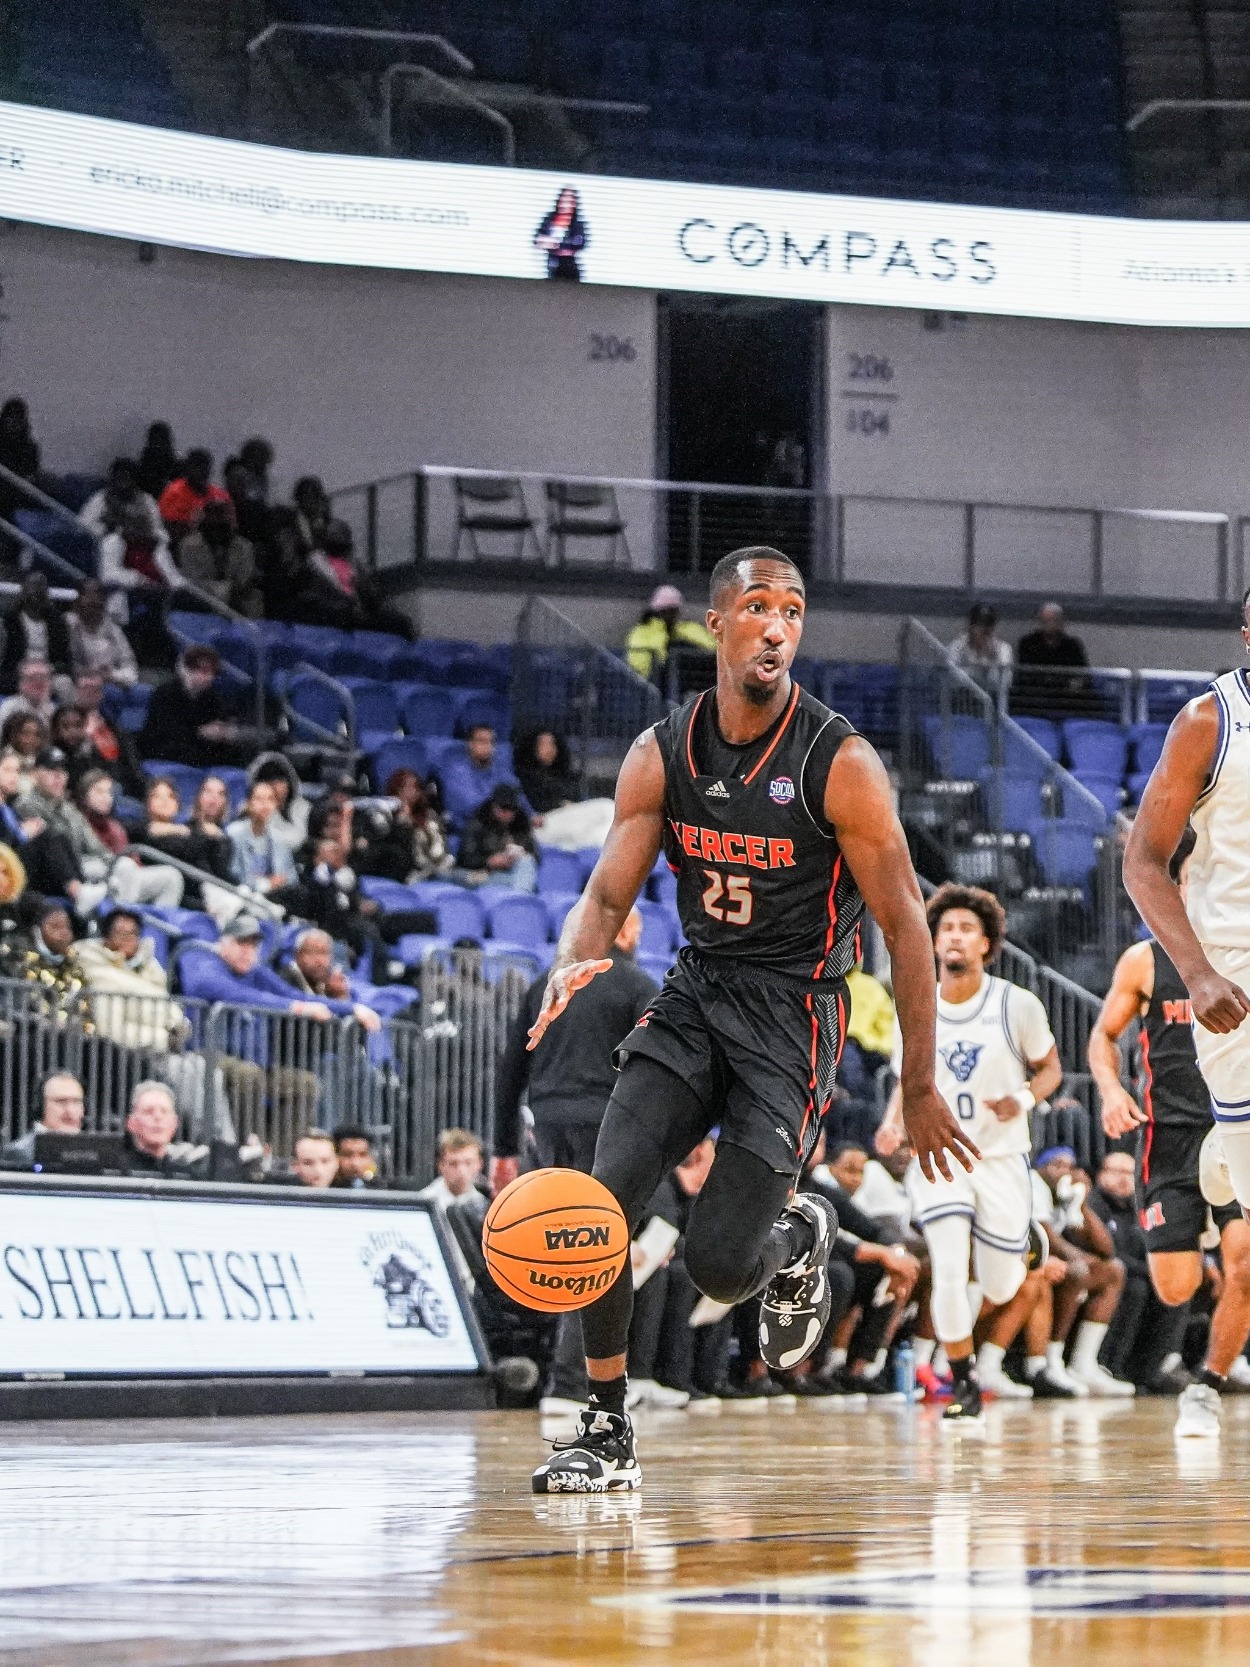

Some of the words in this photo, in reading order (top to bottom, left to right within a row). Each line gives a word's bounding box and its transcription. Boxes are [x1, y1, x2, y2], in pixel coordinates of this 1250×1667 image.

[678, 218, 997, 284] COMPASS
[589, 333, 637, 362] 206
[848, 352, 894, 381] 206
[846, 408, 889, 436] 104
[705, 790, 730, 798] adidas
[702, 868, 753, 926] 25
[957, 1093, 974, 1120] 0
[544, 1226, 610, 1250] NCAA
[4, 1244, 315, 1321] SHELLFISH!
[529, 1265, 617, 1296] Wilson
